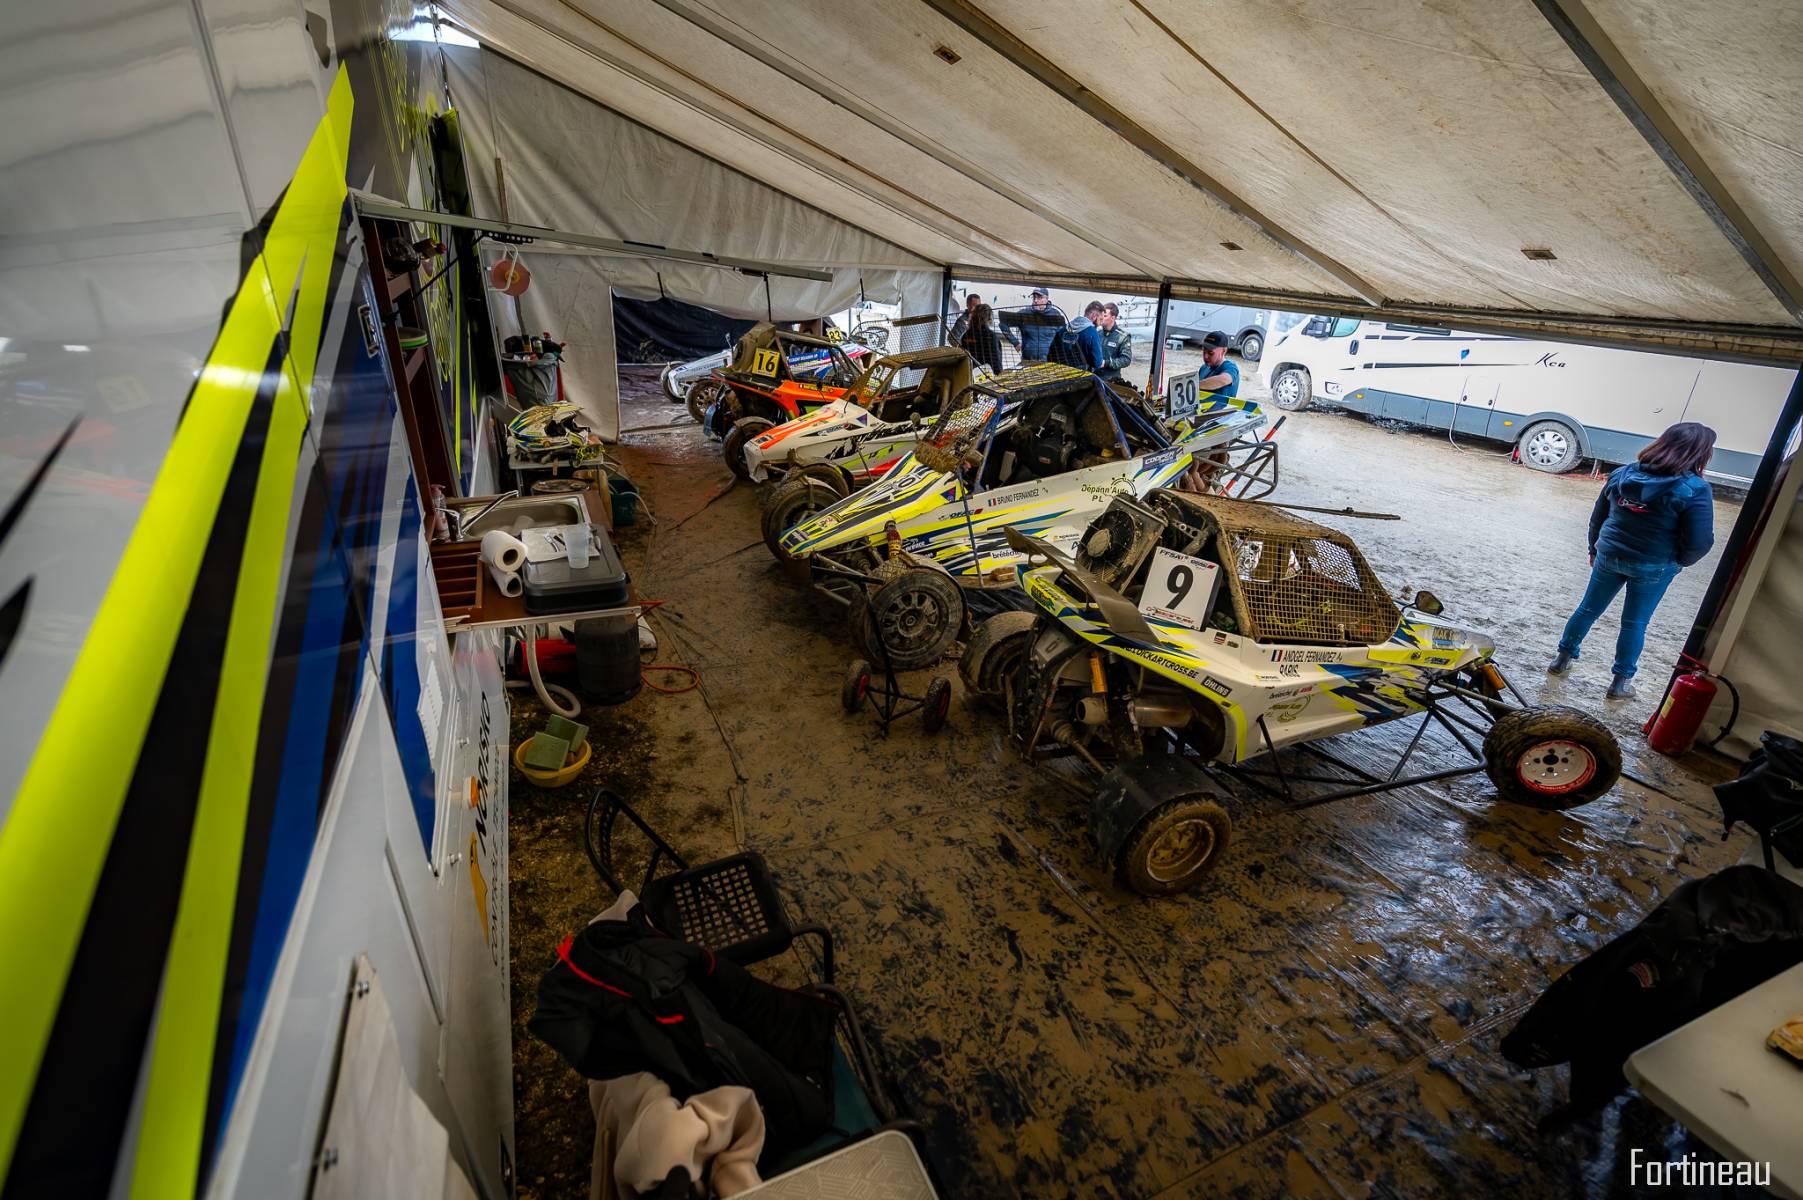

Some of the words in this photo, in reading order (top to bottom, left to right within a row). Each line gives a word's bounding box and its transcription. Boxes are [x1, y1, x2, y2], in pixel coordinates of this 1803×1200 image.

[758, 352, 776, 373] 16
[1174, 379, 1197, 409] 30
[996, 493, 1013, 505] BRUNO
[1013, 488, 1040, 504] FERNANDEZ
[1165, 564, 1194, 610] 9
[1304, 650, 1337, 663] FERNANDEZ
[475, 690, 491, 857] NORISKO
